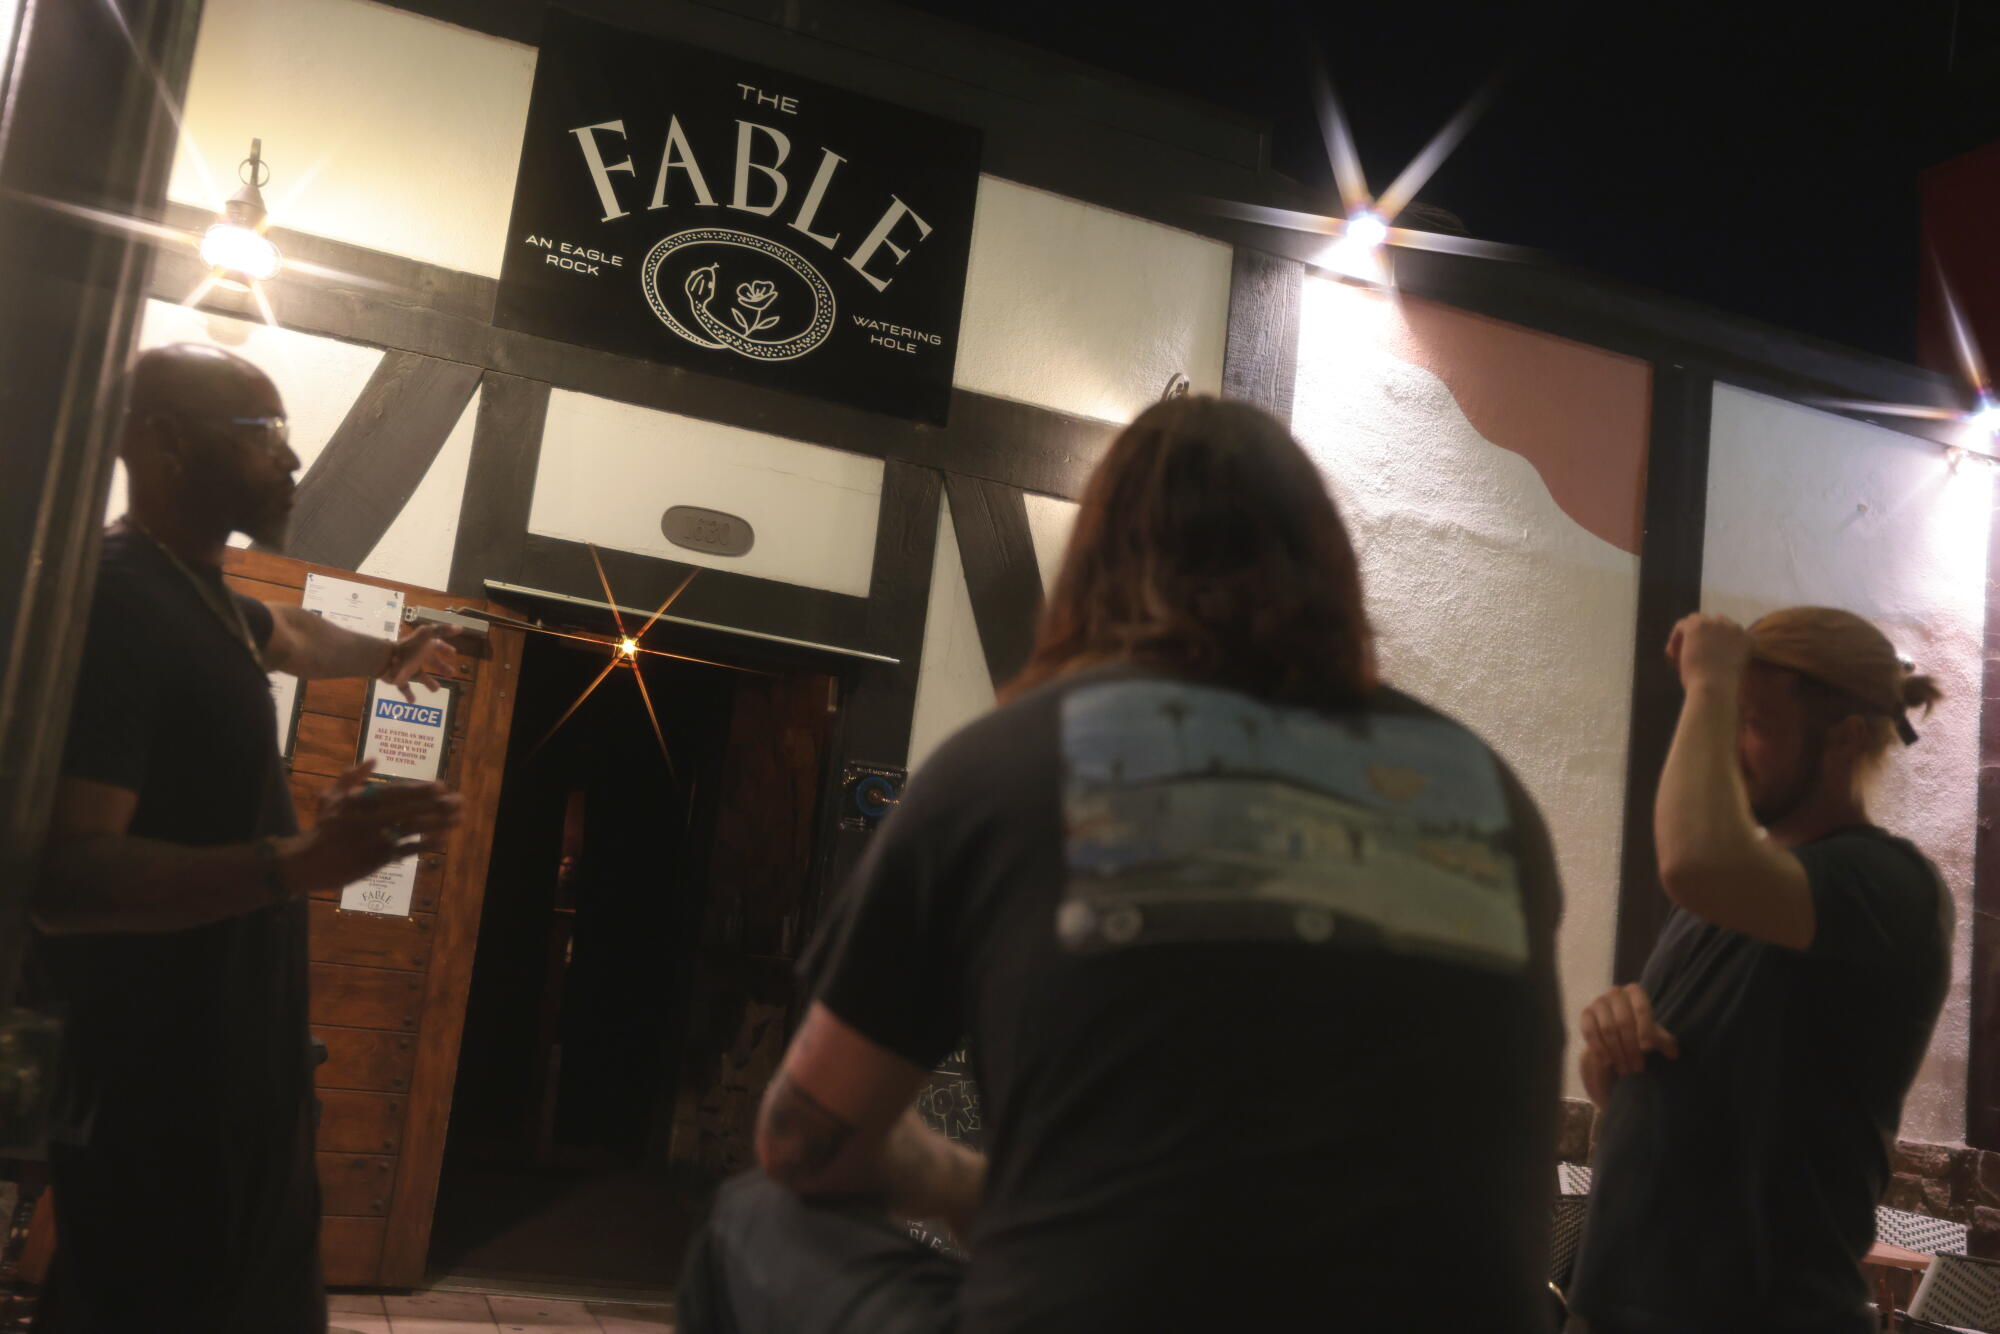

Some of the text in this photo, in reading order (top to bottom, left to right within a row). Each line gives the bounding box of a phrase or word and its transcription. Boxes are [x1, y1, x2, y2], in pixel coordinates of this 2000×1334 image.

[737, 83, 799, 115] THE
[568, 113, 933, 293] FABLE
[525, 234, 624, 267] AN EAGLE
[545, 253, 600, 277] ROCK
[852, 314, 943, 346] WATERING
[870, 334, 917, 354] HOLE
[379, 702, 440, 724] NOTICE
